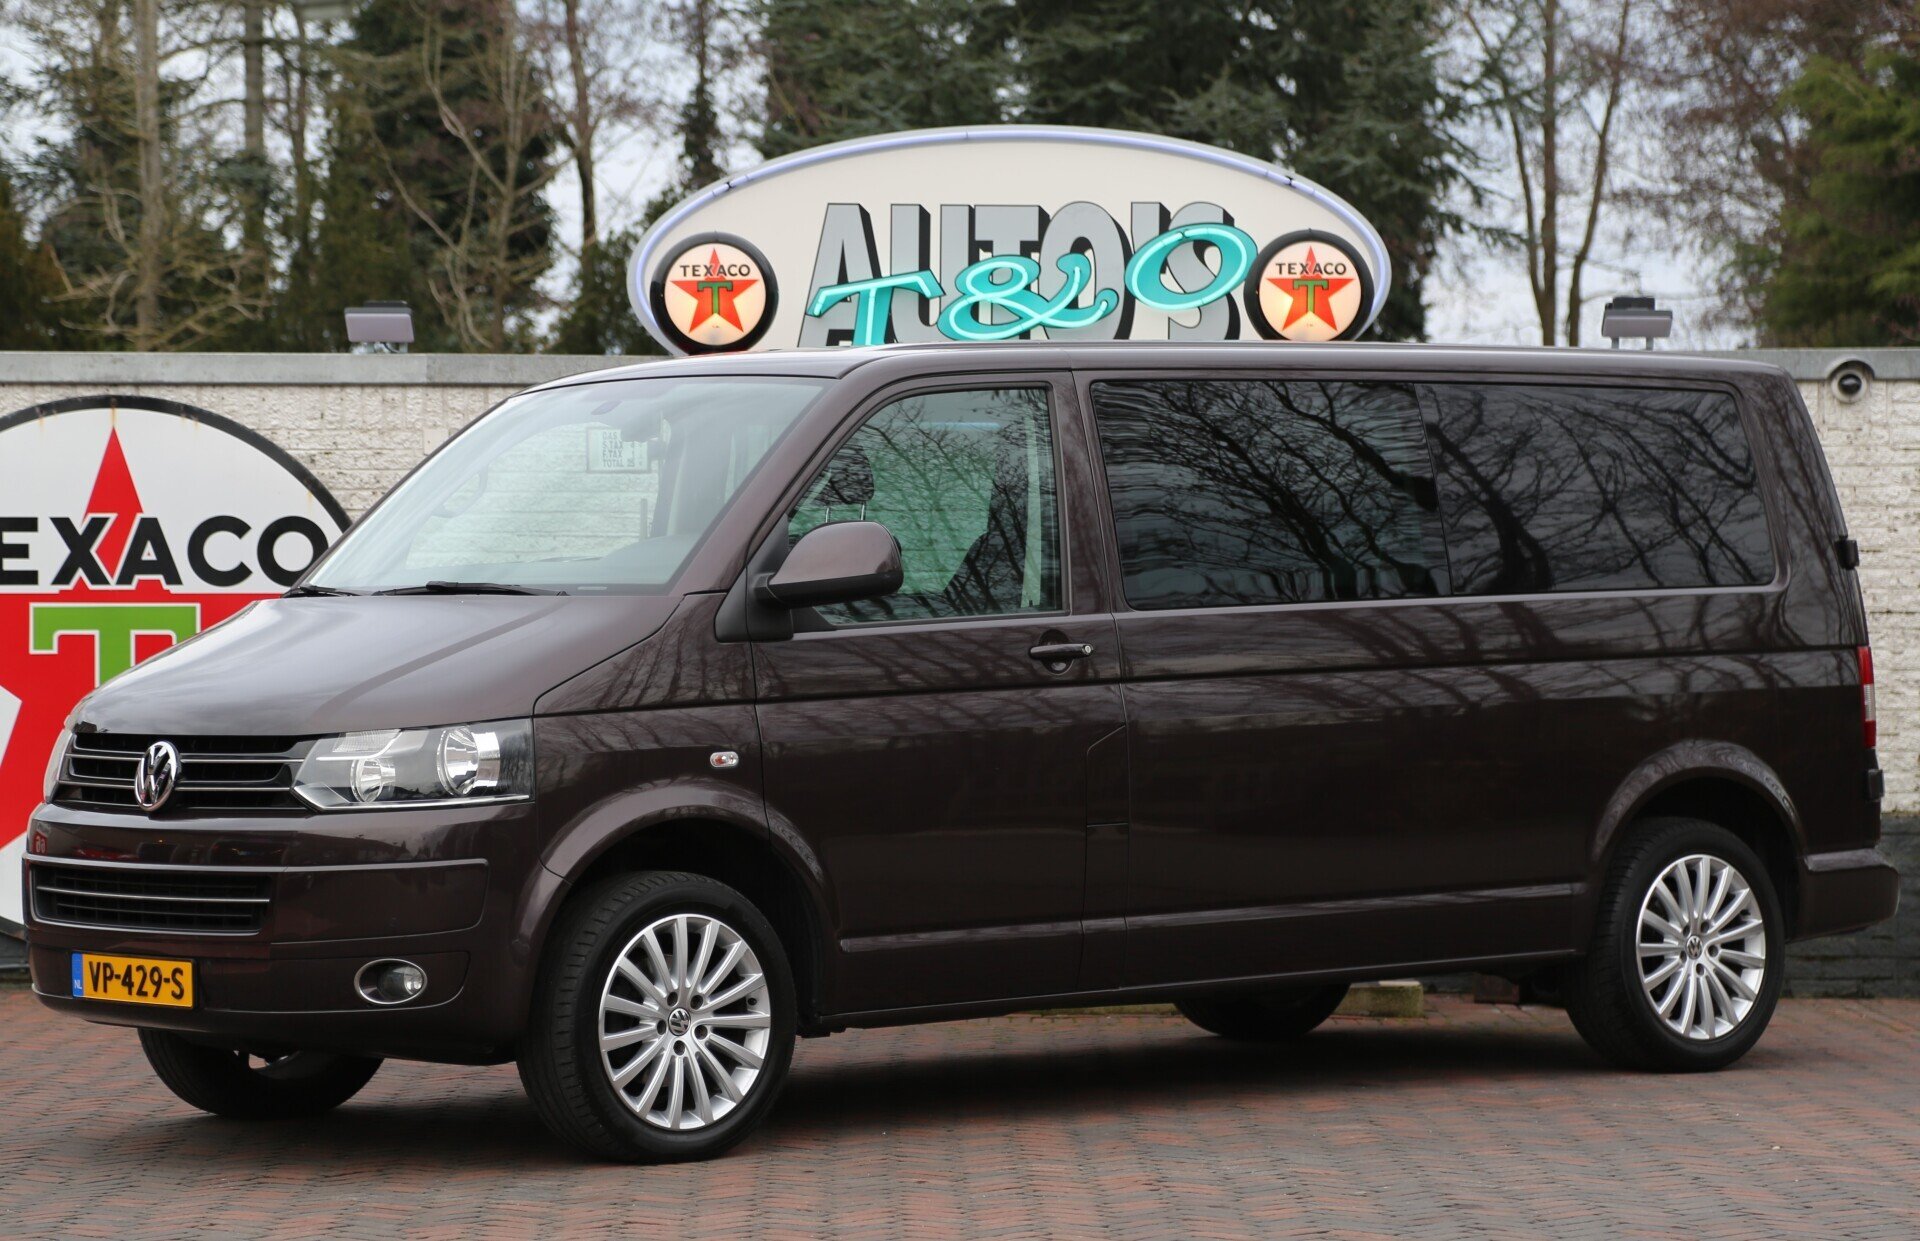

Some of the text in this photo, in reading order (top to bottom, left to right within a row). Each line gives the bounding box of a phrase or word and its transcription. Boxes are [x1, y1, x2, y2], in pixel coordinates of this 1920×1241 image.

[680, 264, 751, 277] TEXACO
[806, 222, 1257, 345] T & O
[1275, 262, 1347, 276] TEXACO
[0, 515, 329, 587] EXACO
[74, 961, 185, 1000] NL VP-429-S
